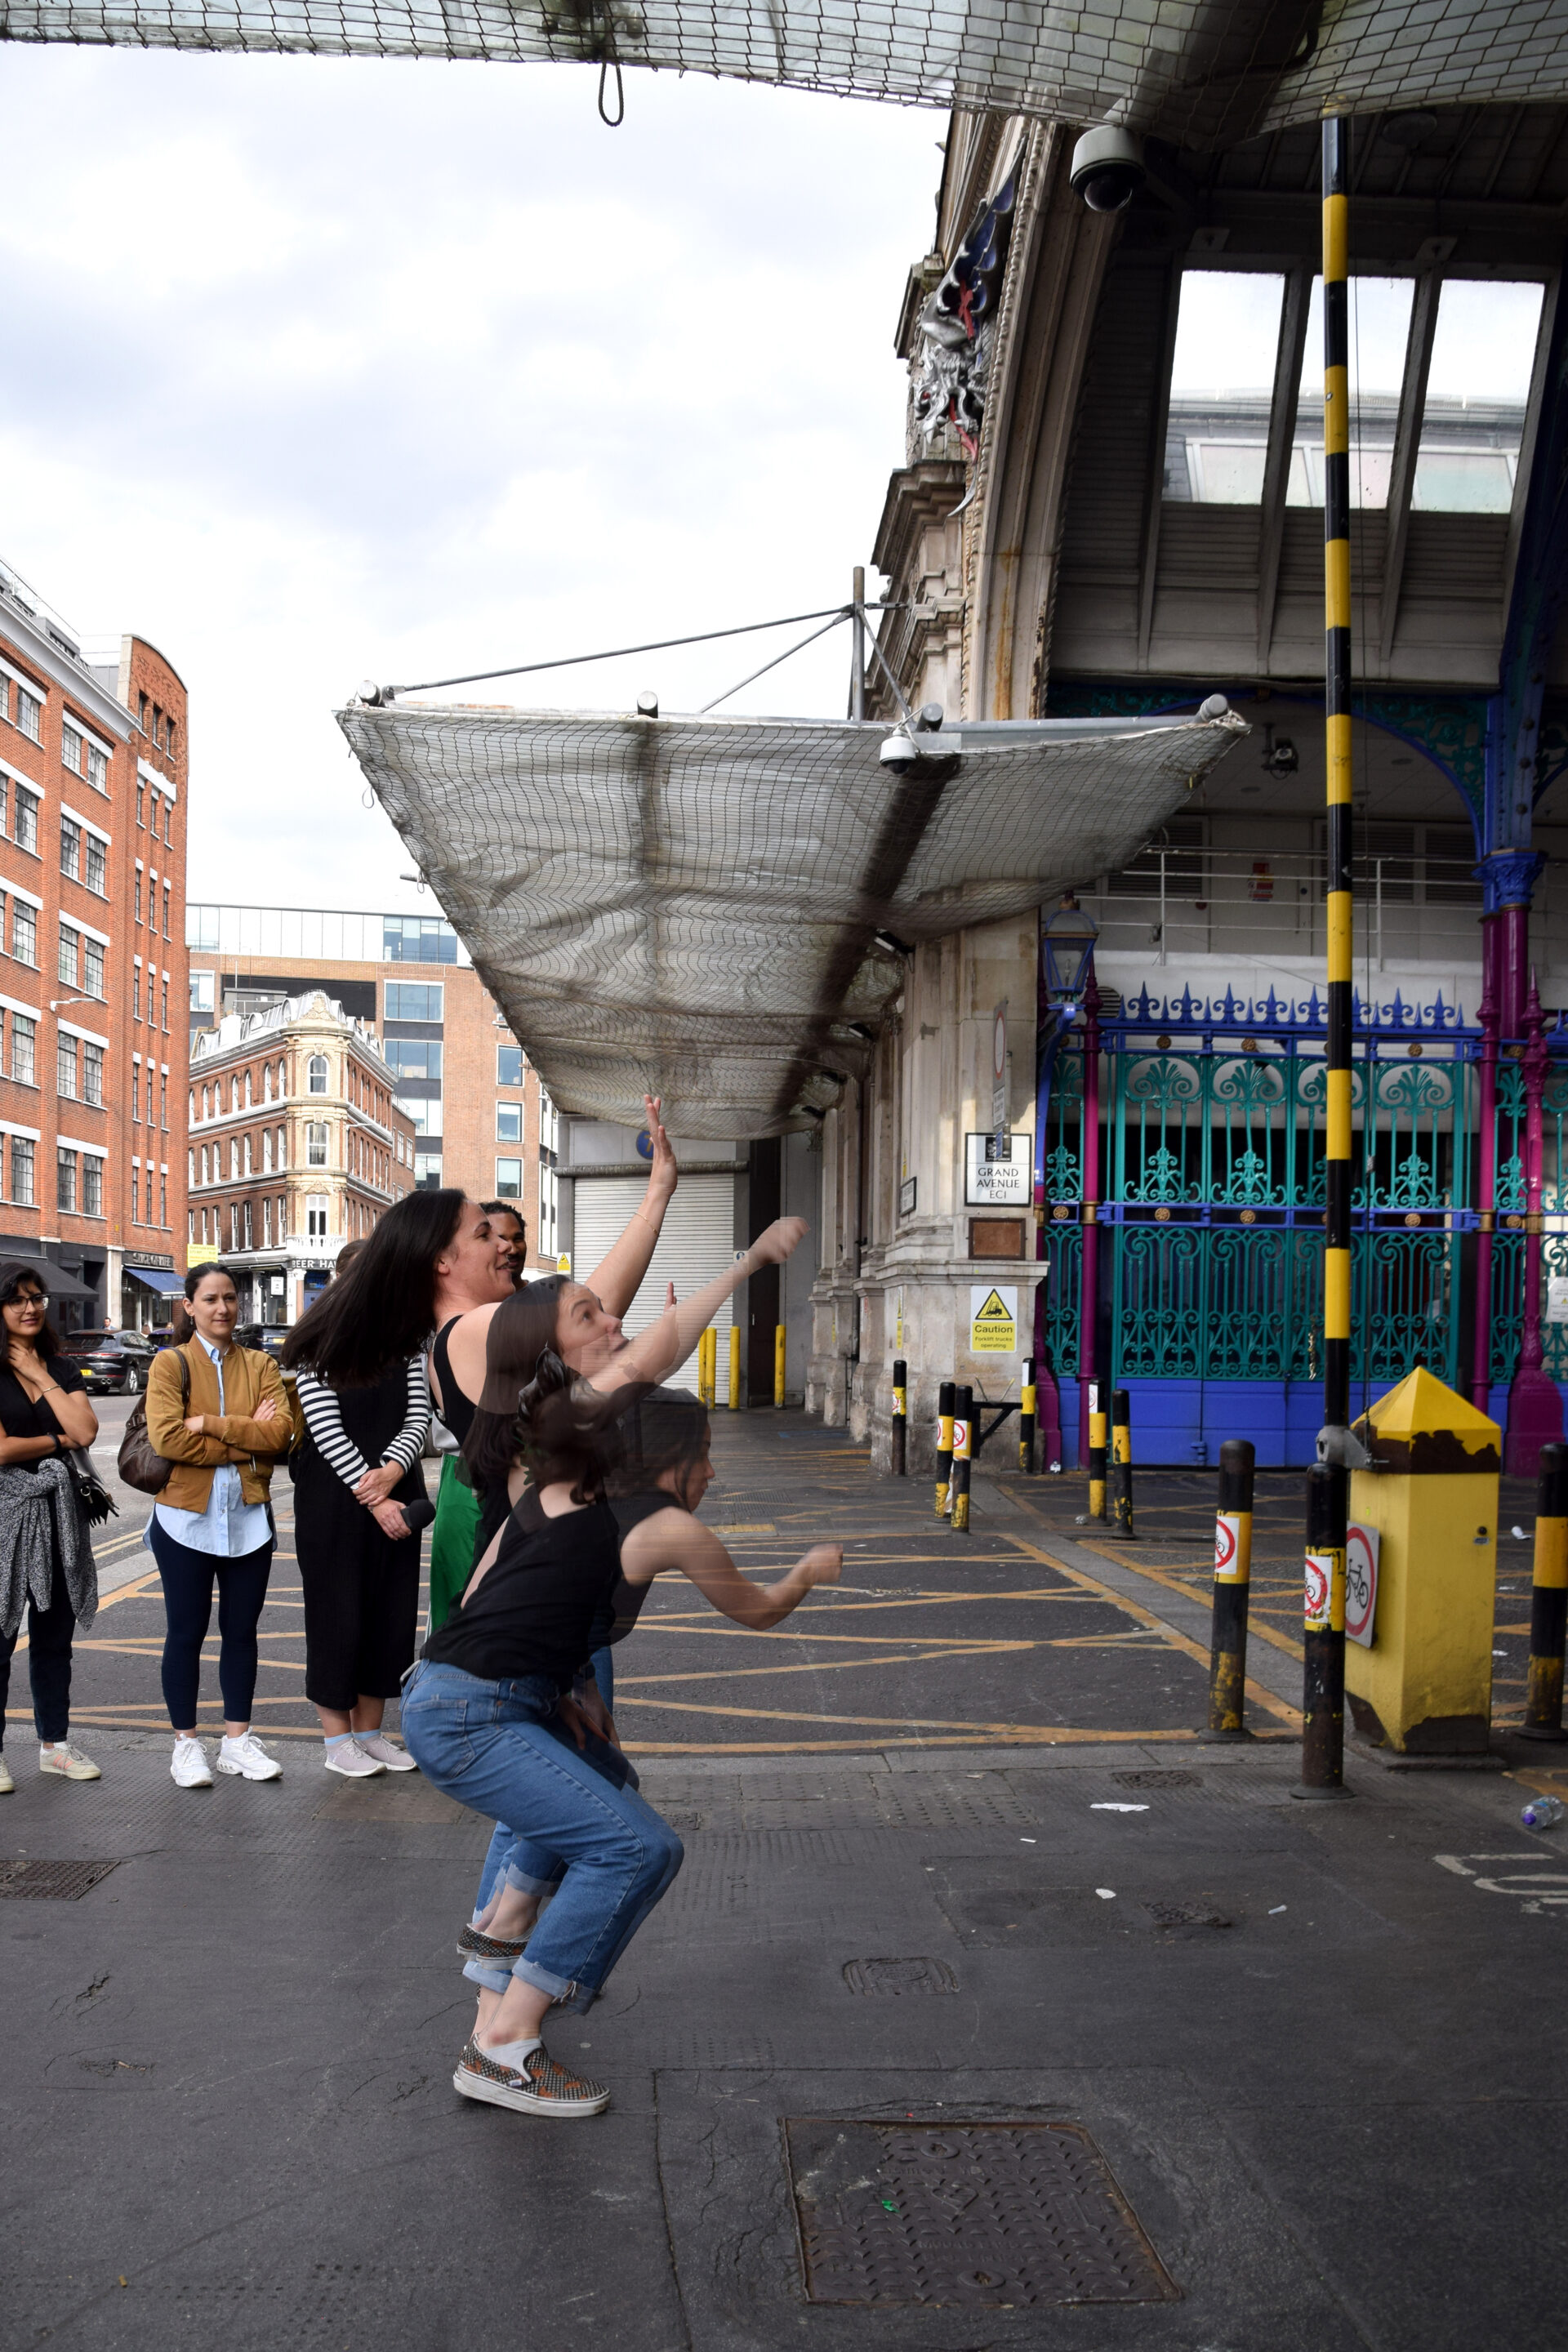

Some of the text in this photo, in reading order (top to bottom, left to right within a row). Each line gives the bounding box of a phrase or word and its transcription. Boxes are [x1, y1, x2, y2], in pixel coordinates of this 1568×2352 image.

[978, 1168, 1018, 1177] GRAND
[977, 1179, 1020, 1188] AVENUE
[292, 1259, 314, 1268] BEER
[974, 1325, 1013, 1334] Caution
